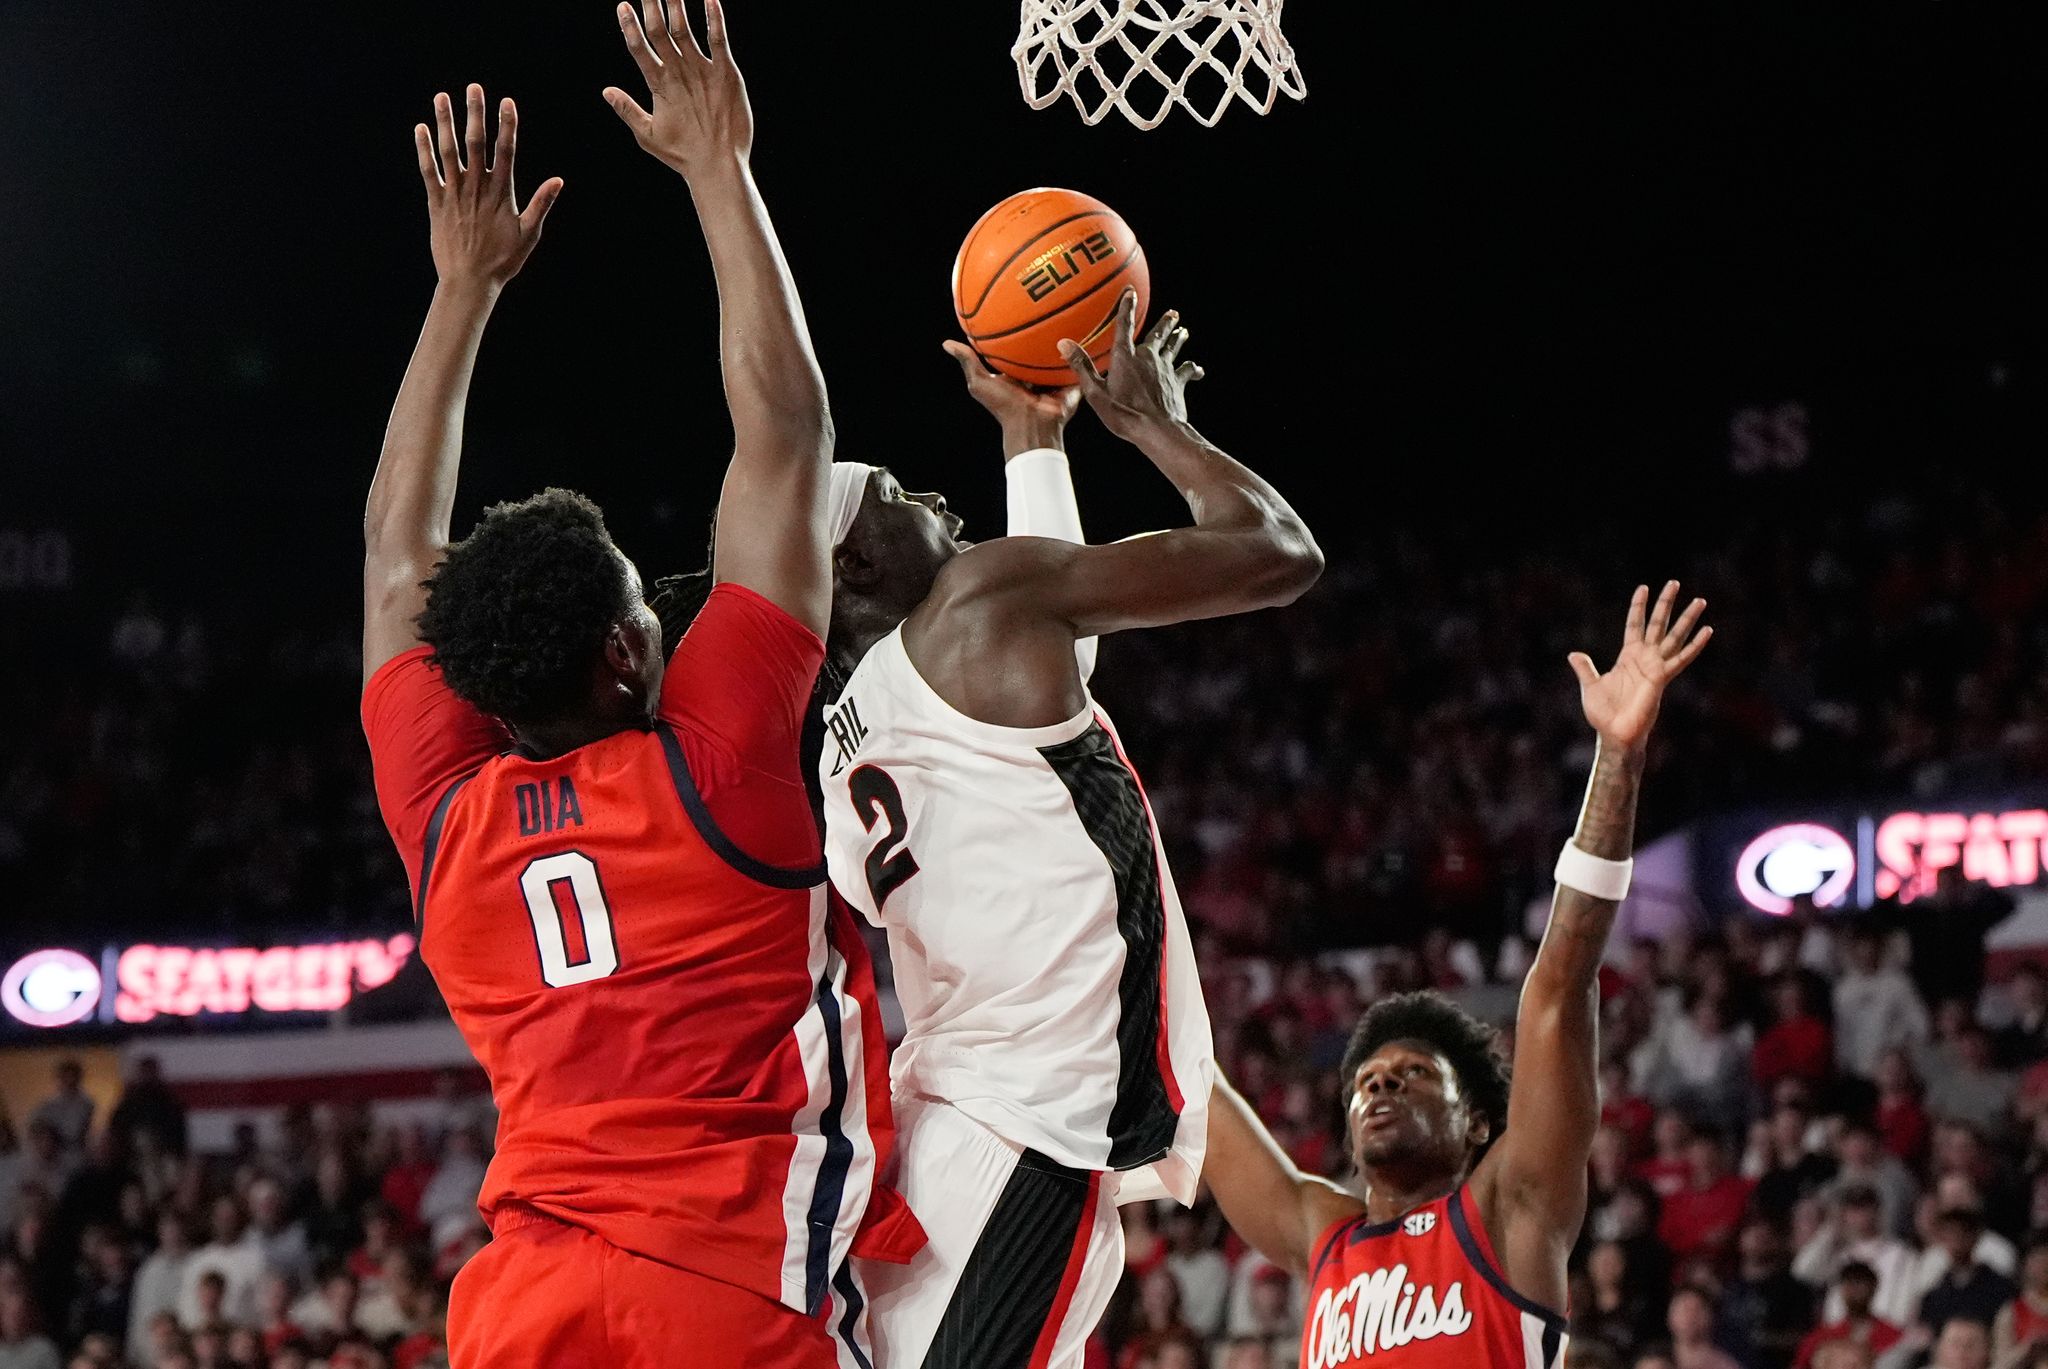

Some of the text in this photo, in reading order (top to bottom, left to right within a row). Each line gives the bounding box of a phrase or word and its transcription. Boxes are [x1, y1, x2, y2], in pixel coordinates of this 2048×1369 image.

[1022, 231, 1116, 302] ELITE
[829, 696, 869, 777] RIL
[515, 776, 583, 836] DIA
[848, 764, 920, 918] 2
[518, 849, 620, 988] 0
[1403, 1211, 1436, 1236] SEC
[1348, 1264, 1472, 1359] Miss
